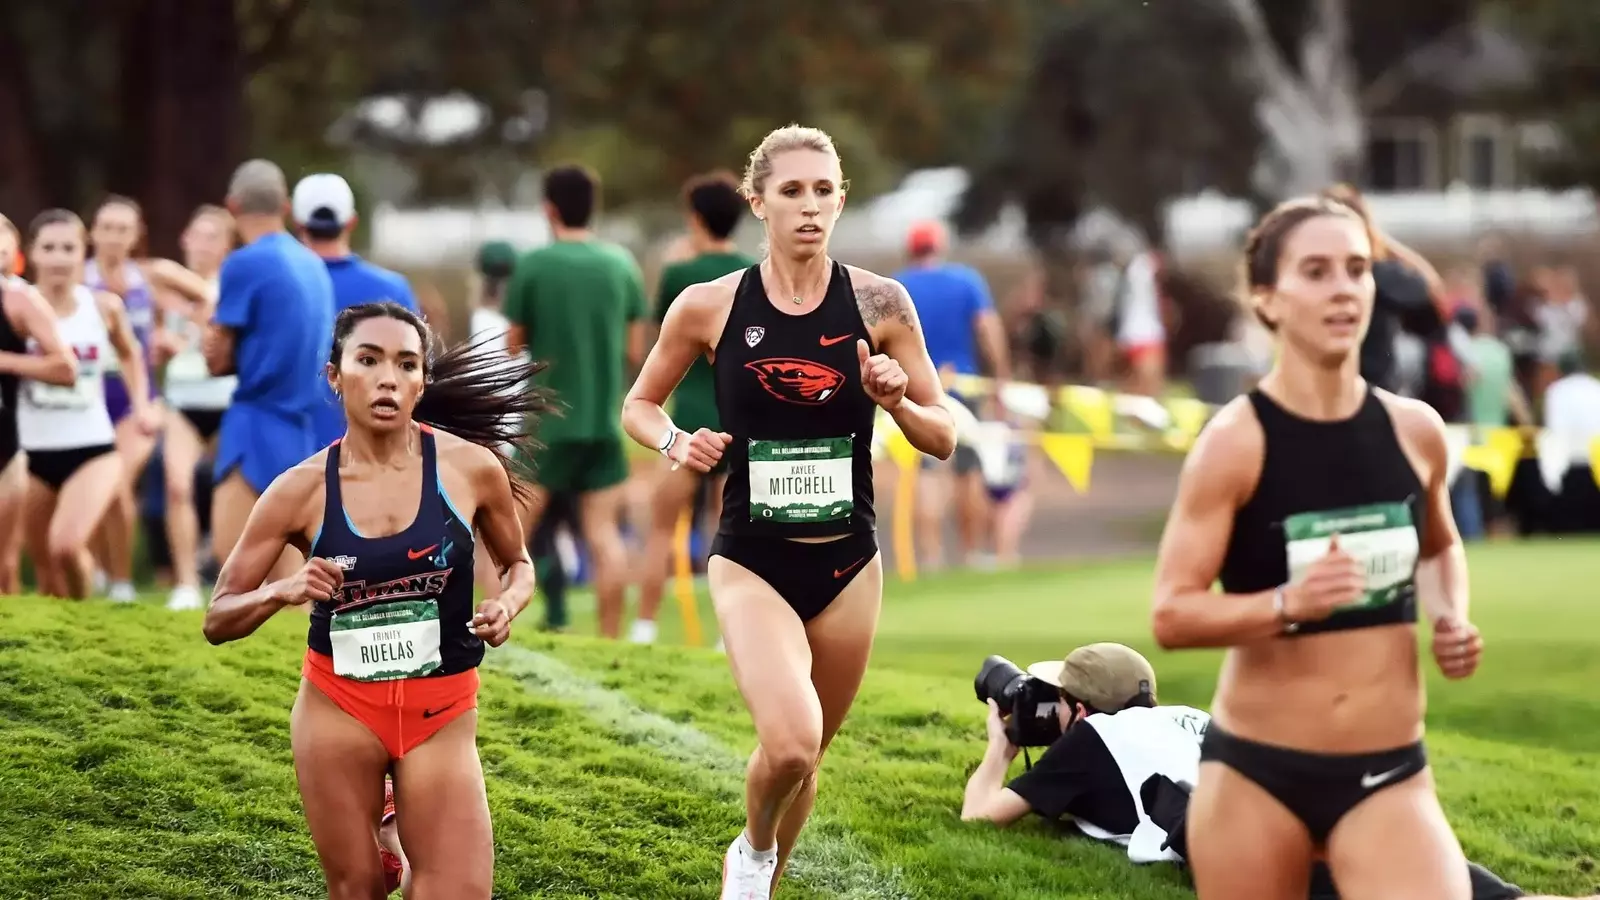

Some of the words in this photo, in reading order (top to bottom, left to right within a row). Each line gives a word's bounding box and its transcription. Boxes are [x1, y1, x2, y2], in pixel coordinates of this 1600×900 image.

[791, 465, 816, 475] KAYLEE
[769, 476, 836, 496] MITCHELL
[372, 630, 402, 642] TRINITY
[361, 641, 415, 665] RUELAS
